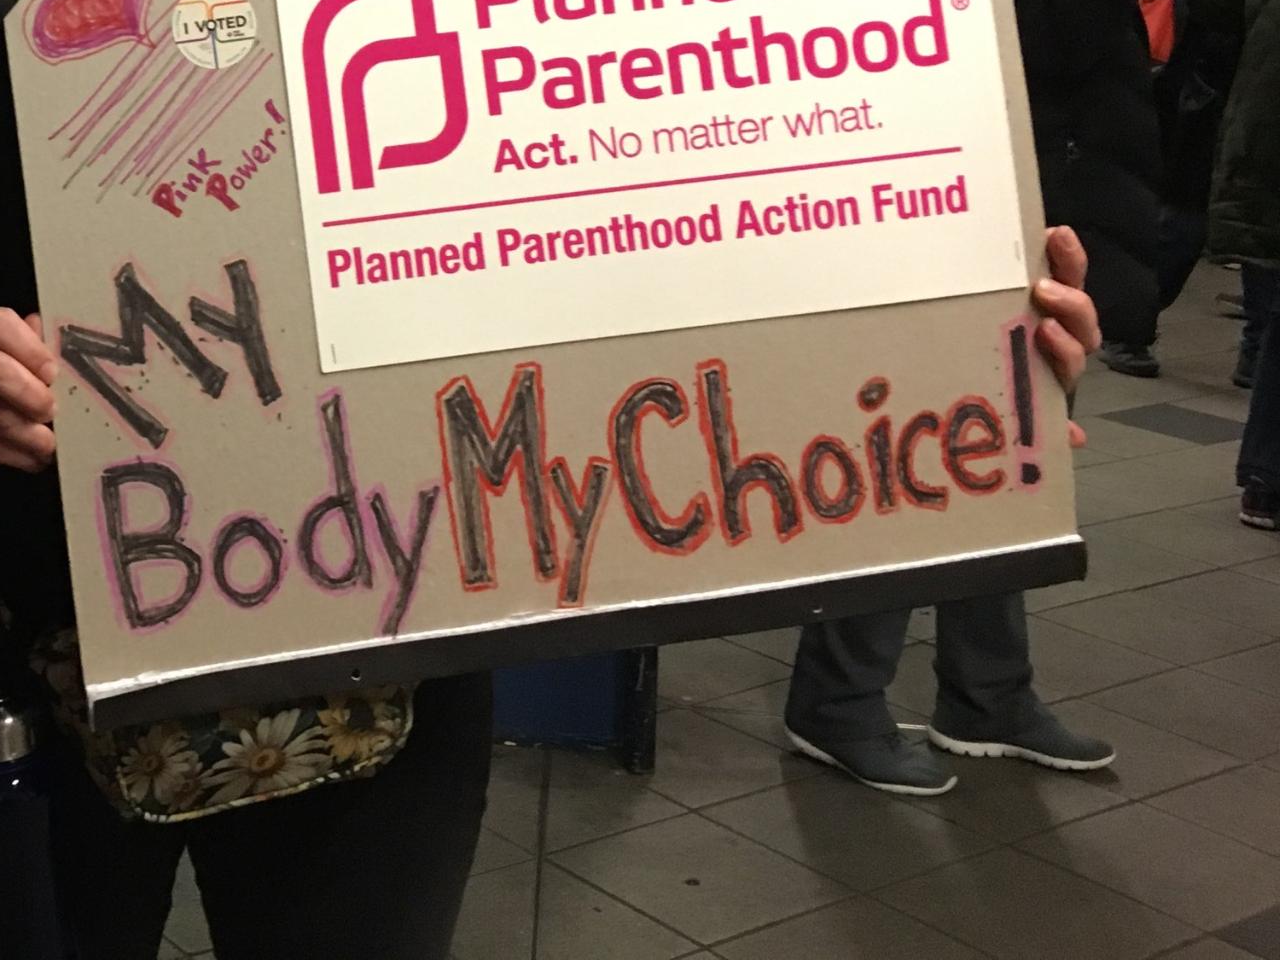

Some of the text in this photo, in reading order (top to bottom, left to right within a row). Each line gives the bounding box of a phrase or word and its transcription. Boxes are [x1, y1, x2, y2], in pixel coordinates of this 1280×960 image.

[183, 22, 189, 35] I
[194, 15, 247, 33] VOTED
[204, 98, 288, 212] Power!
[494, 98, 884, 173] Act. No matter what.
[152, 148, 222, 218] Pink
[328, 174, 969, 288] Planned Parenthood Action Fund
[99, 387, 441, 640] Body
